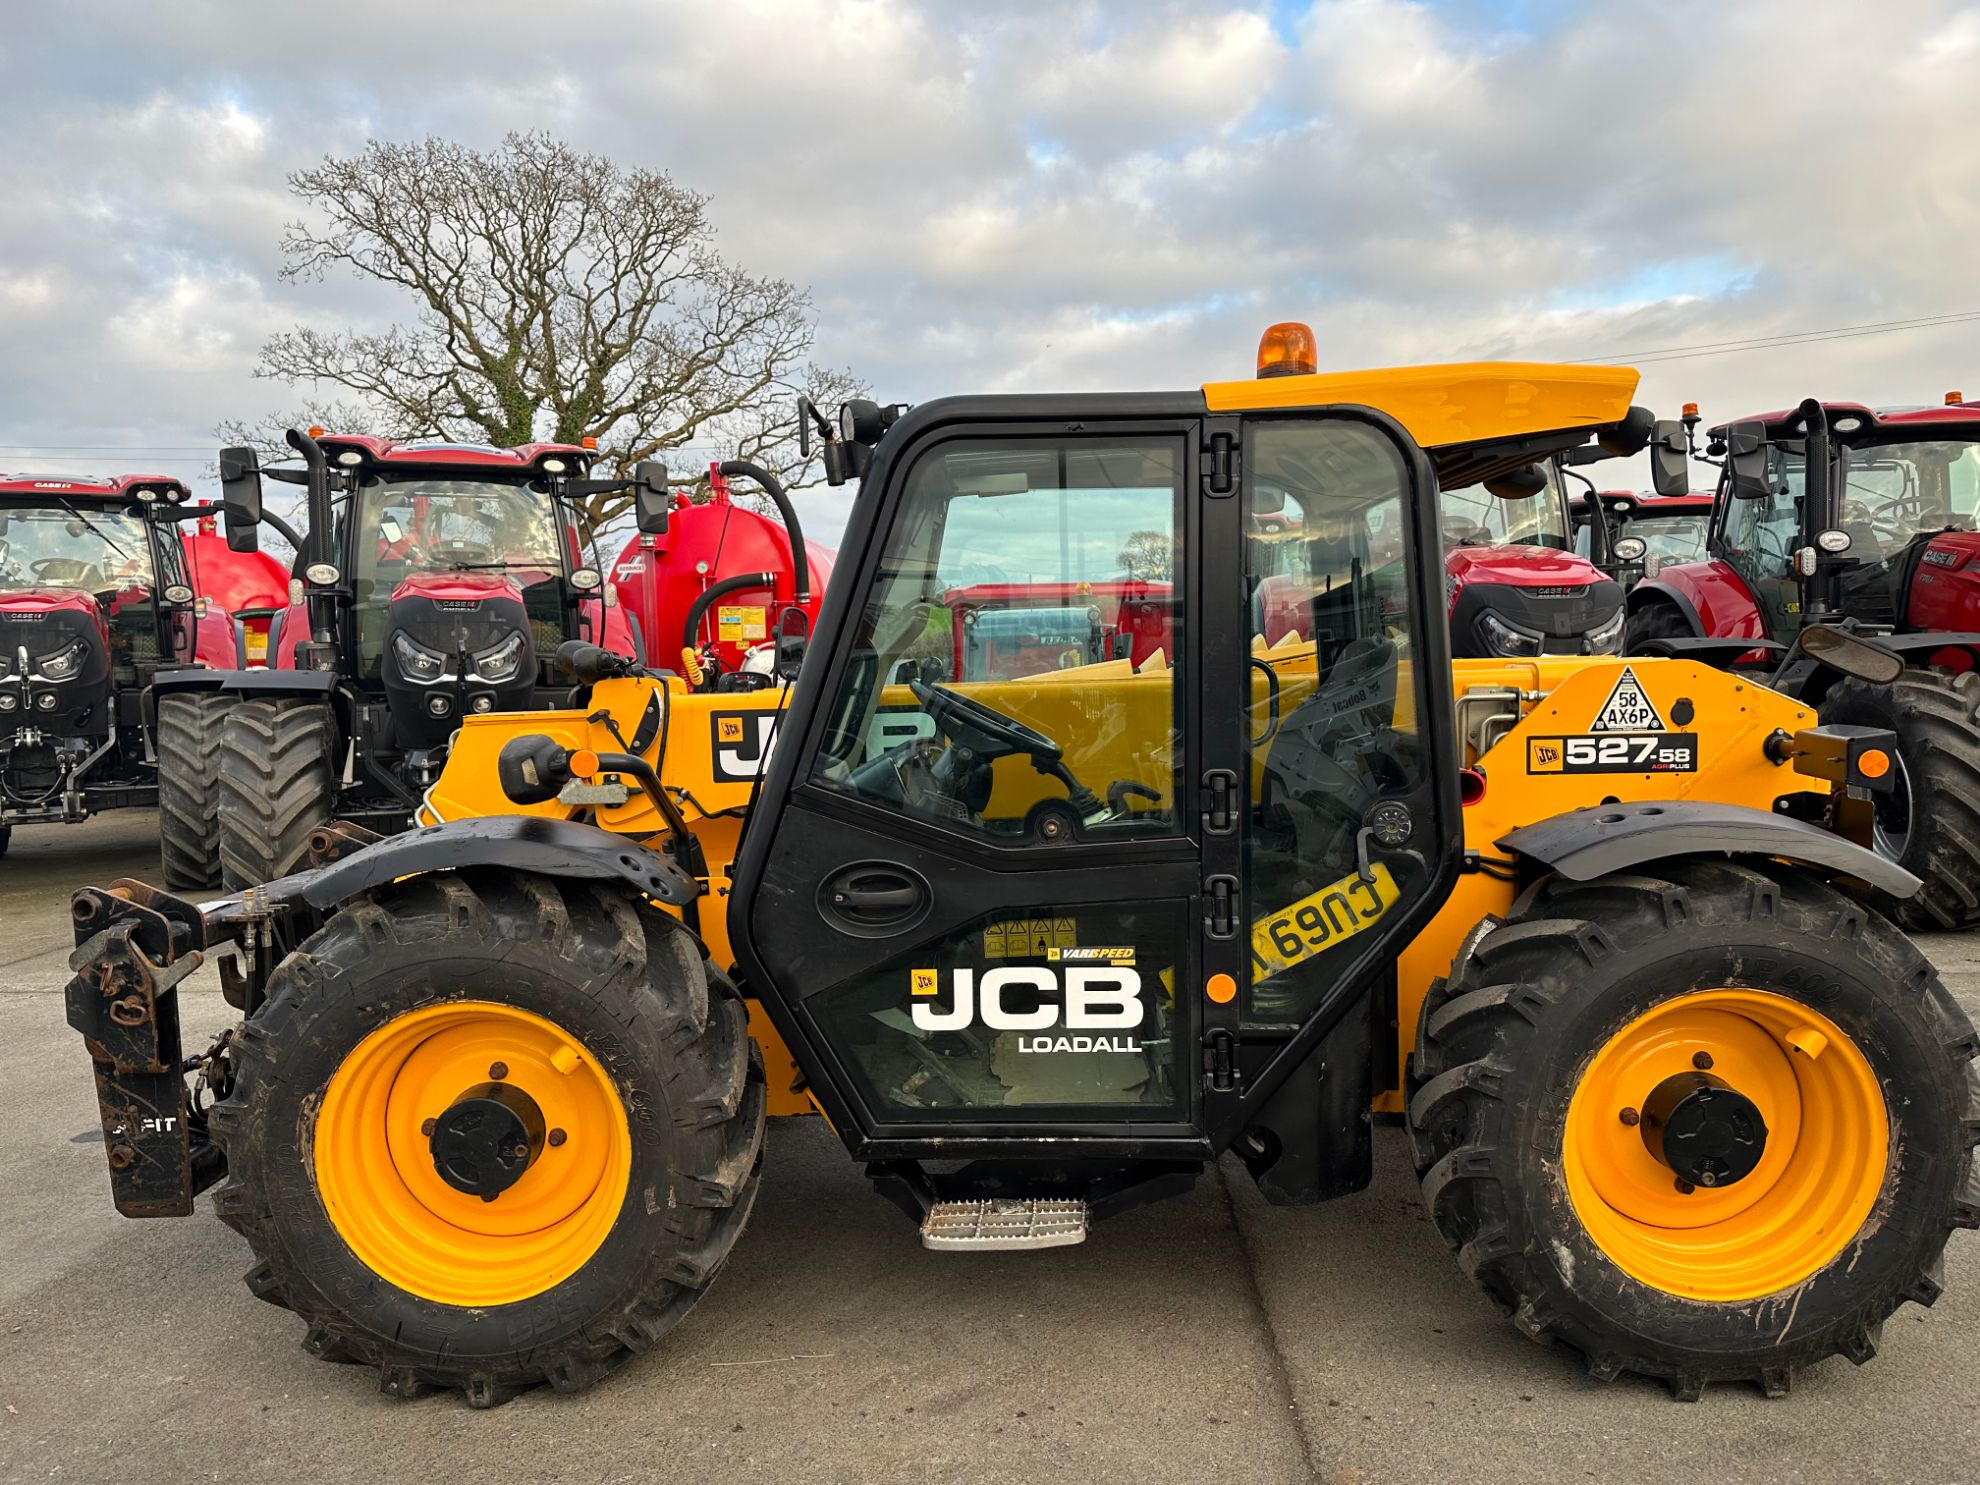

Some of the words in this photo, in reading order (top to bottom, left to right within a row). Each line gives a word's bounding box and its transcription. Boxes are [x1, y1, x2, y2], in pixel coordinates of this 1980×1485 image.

[1619, 692, 1637, 707] 58
[1608, 708, 1649, 725] AX6P
[1538, 745, 1559, 764] JCB
[1566, 737, 1690, 765] 527-58
[1063, 948, 1134, 959] VARISPEED
[917, 975, 933, 988] JCB
[911, 966, 1144, 1031] JCB
[1018, 1036, 1143, 1053] LOADALL
